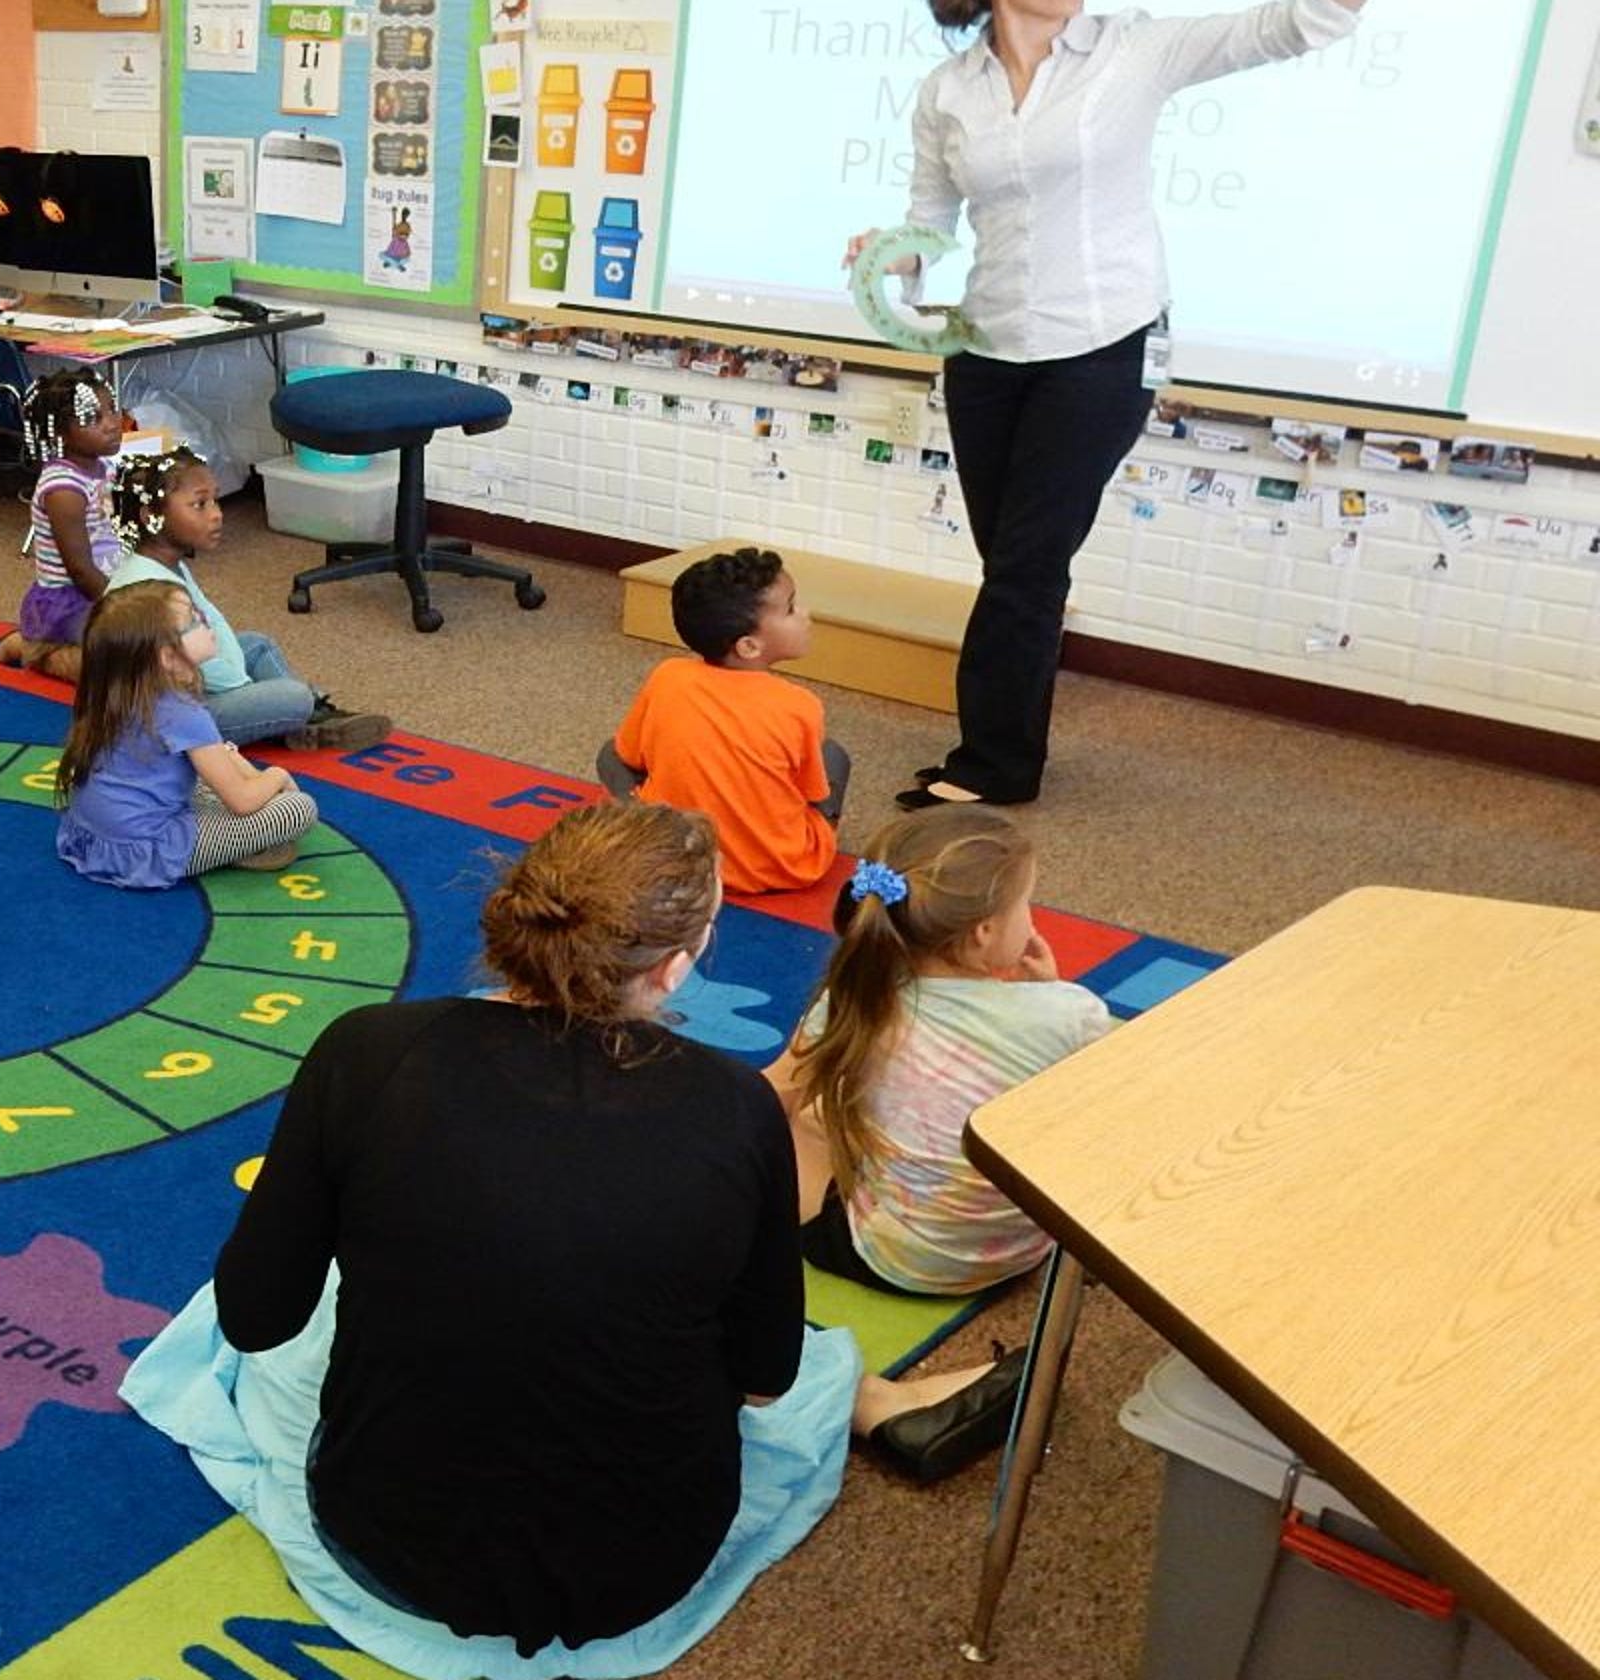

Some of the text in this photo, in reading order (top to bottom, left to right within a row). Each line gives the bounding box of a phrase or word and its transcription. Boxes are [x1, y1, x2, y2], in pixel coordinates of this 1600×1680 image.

[193, 25, 245, 49] 3 1
[398, 189, 428, 204] Rules
[338, 741, 456, 785] Ee
[279, 874, 326, 900] 3
[290, 931, 337, 961] 4
[239, 993, 304, 1025] 5
